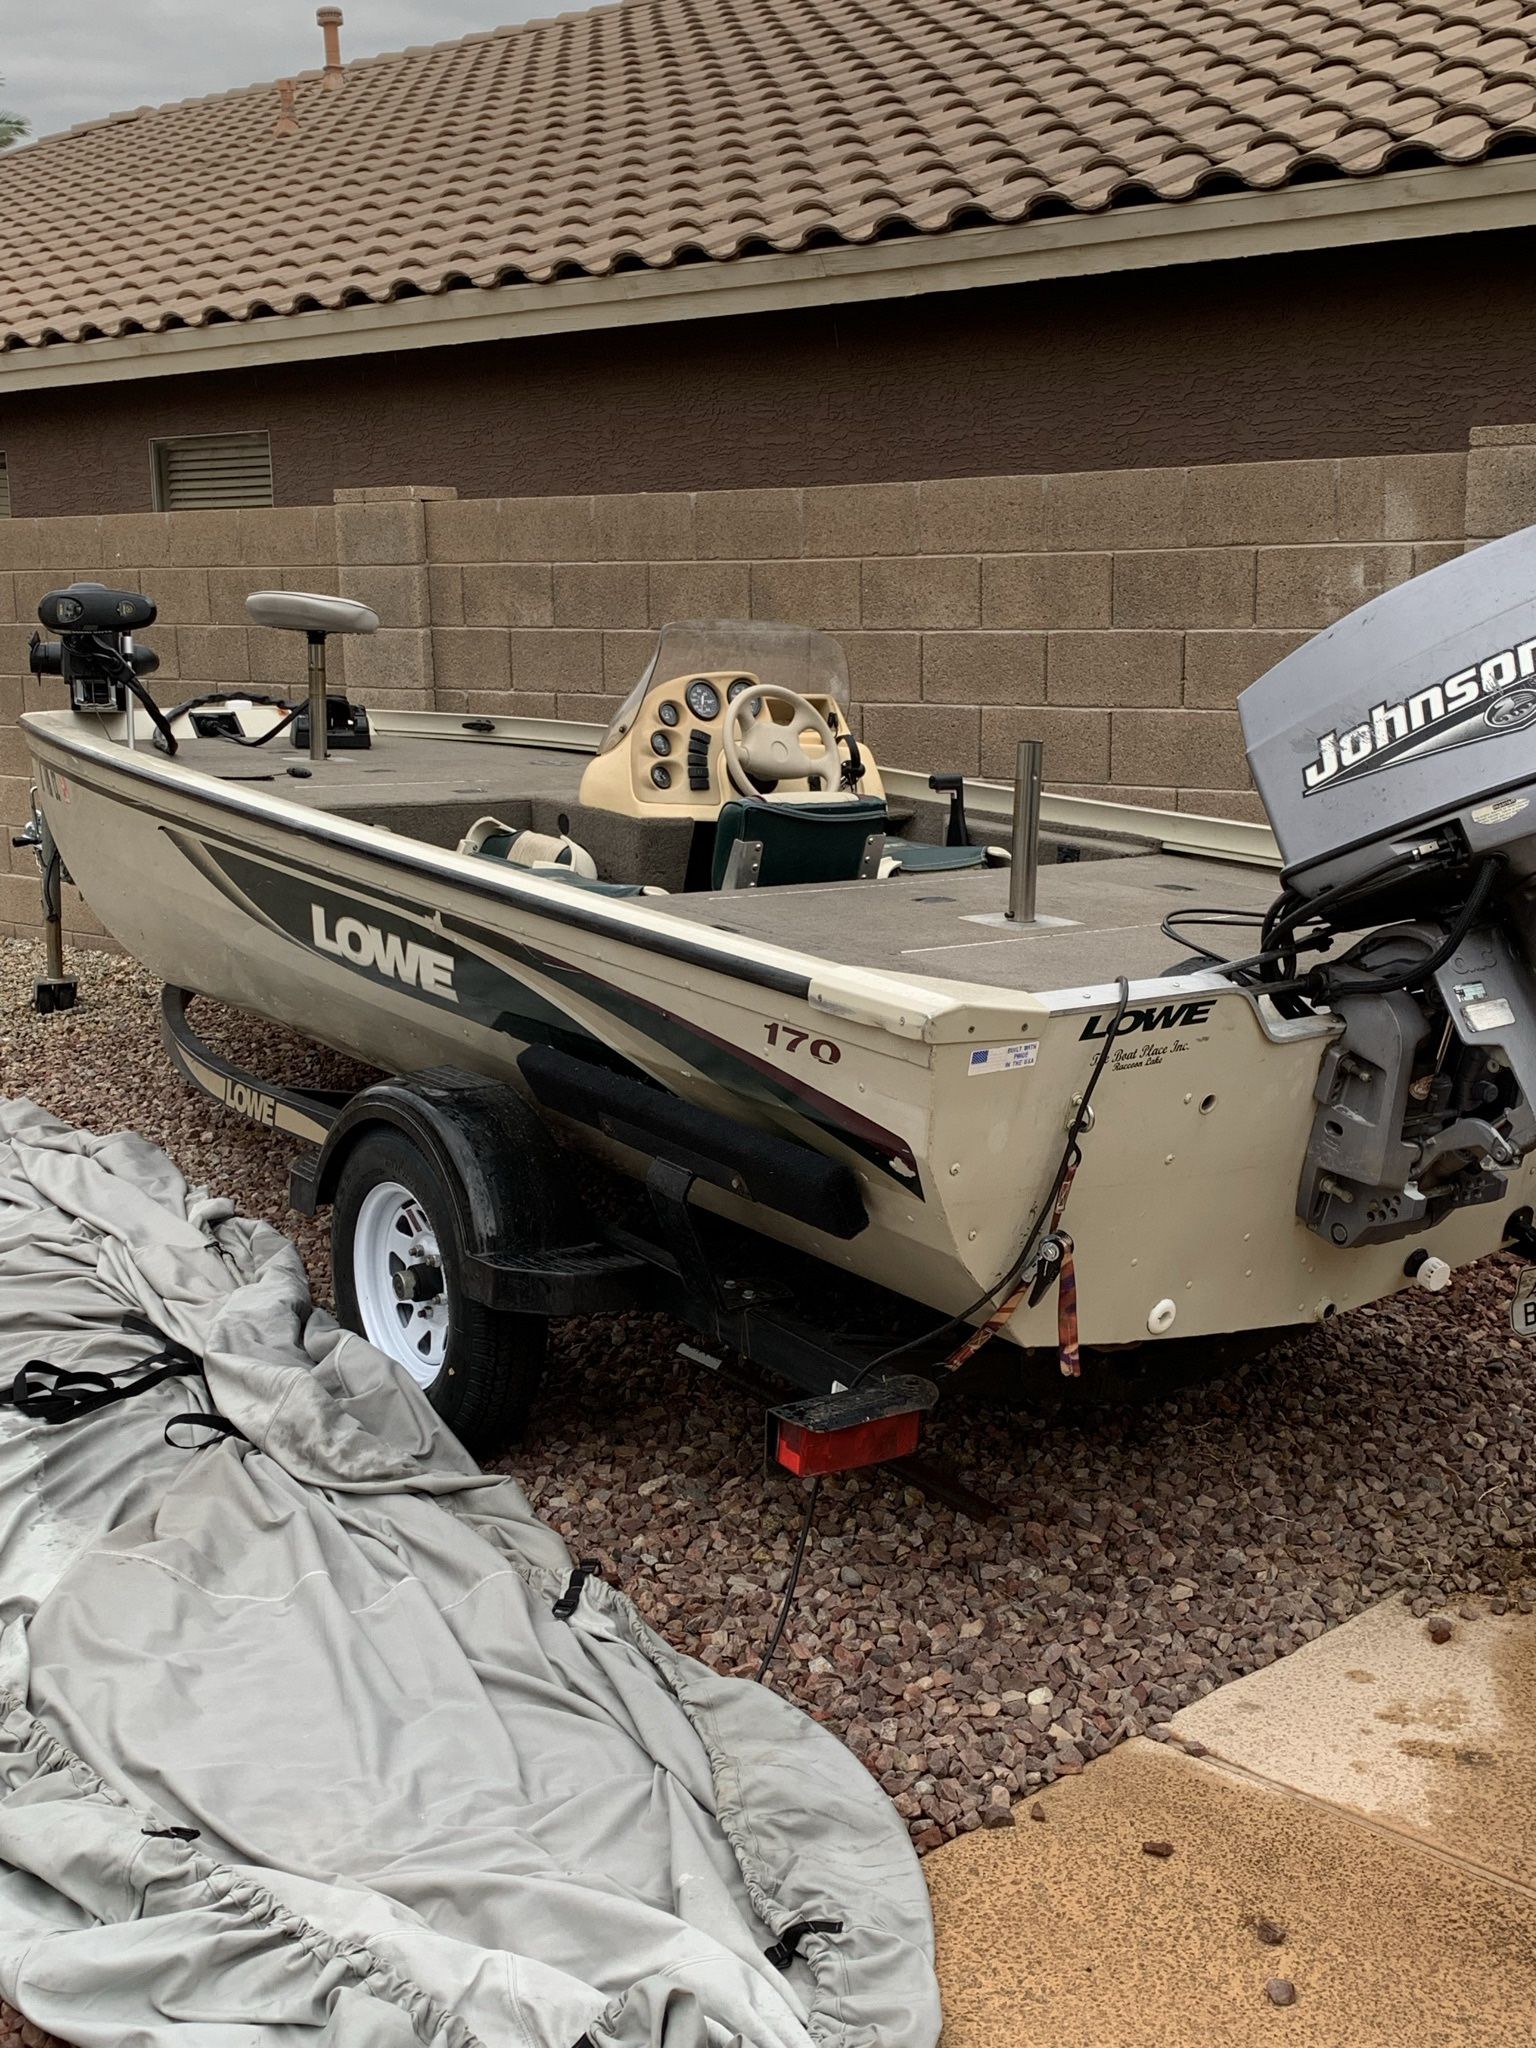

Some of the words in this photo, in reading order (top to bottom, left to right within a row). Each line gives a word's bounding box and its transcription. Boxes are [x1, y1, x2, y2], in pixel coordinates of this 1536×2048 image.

[1303, 637, 1536, 788] Johnson
[311, 903, 459, 1004] LOWE
[1078, 1000, 1218, 1041] LOWE
[764, 1022, 841, 1065] 170
[1090, 1053, 1110, 1066] Te
[1112, 1048, 1137, 1063] Boat
[1139, 1043, 1168, 1058] Place
[1112, 1061, 1143, 1071] Raccoon
[1144, 1058, 1163, 1067] Lake
[225, 1079, 275, 1127] LOWE
